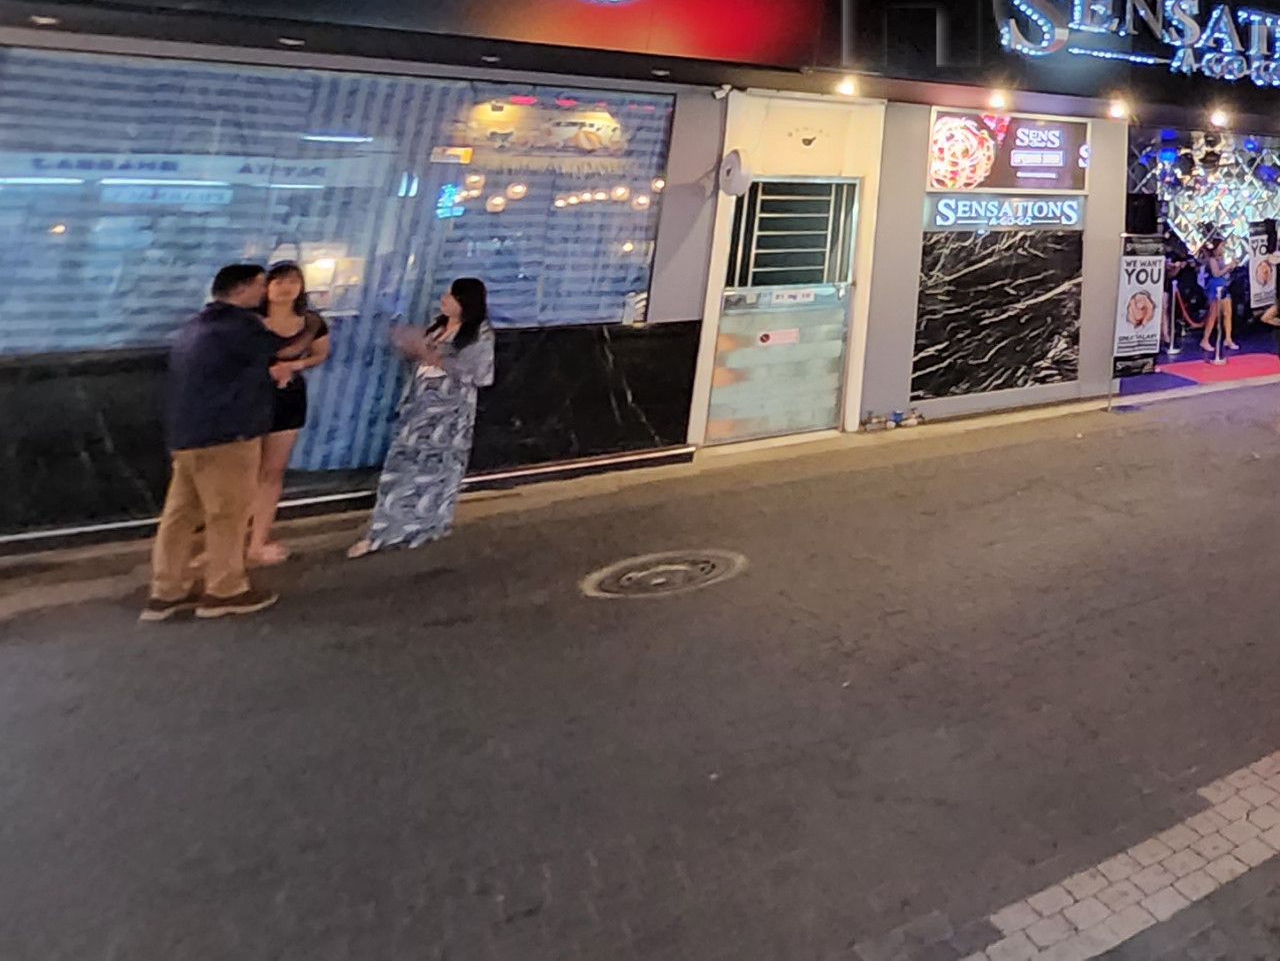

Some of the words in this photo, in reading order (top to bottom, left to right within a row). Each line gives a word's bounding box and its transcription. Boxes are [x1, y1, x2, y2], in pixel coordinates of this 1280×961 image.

[1015, 127, 1060, 148] SENS
[936, 198, 1078, 226] SENSATIONS
[1124, 268, 1162, 285] YOU
